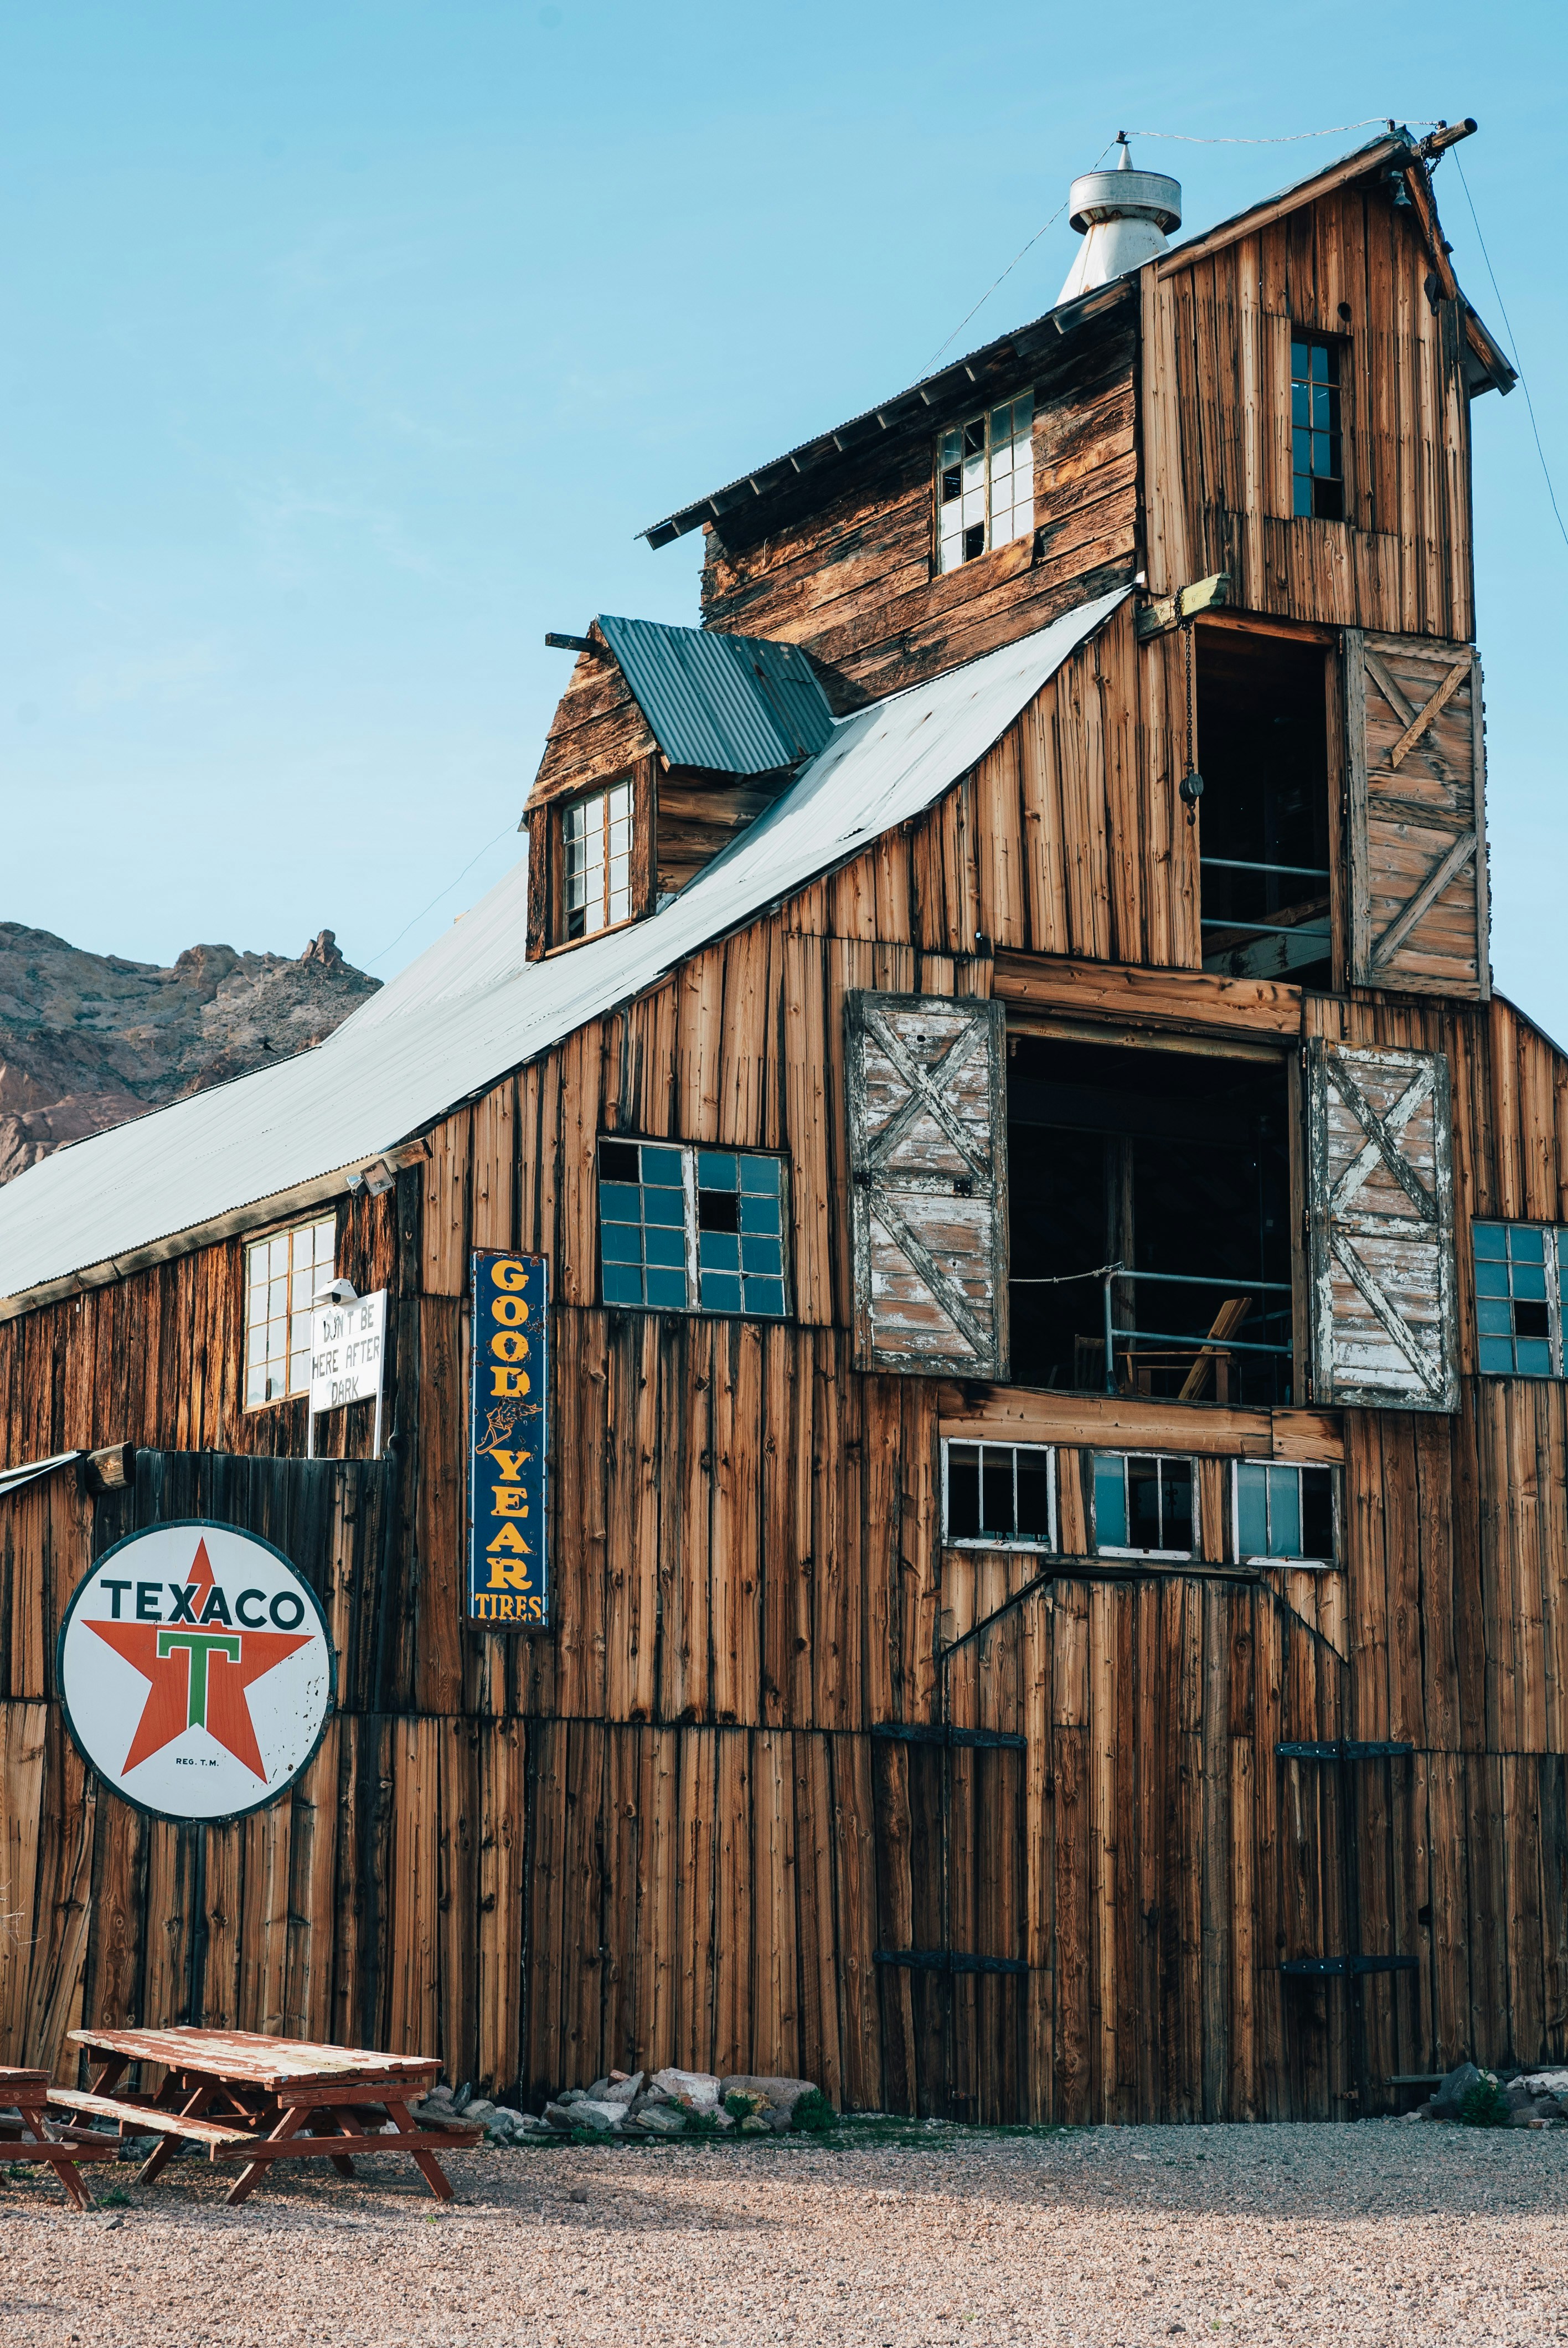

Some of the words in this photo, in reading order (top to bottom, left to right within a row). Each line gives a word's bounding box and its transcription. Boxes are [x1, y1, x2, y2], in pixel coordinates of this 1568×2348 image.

[361, 1304, 374, 1330] BE
[312, 1349, 339, 1379] HERE
[346, 1336, 379, 1368] AFTER
[332, 1376, 359, 1406] DARK
[100, 1580, 305, 1630] TEXACO
[475, 1593, 541, 1621] TIRES
[157, 1630, 242, 1730] T
